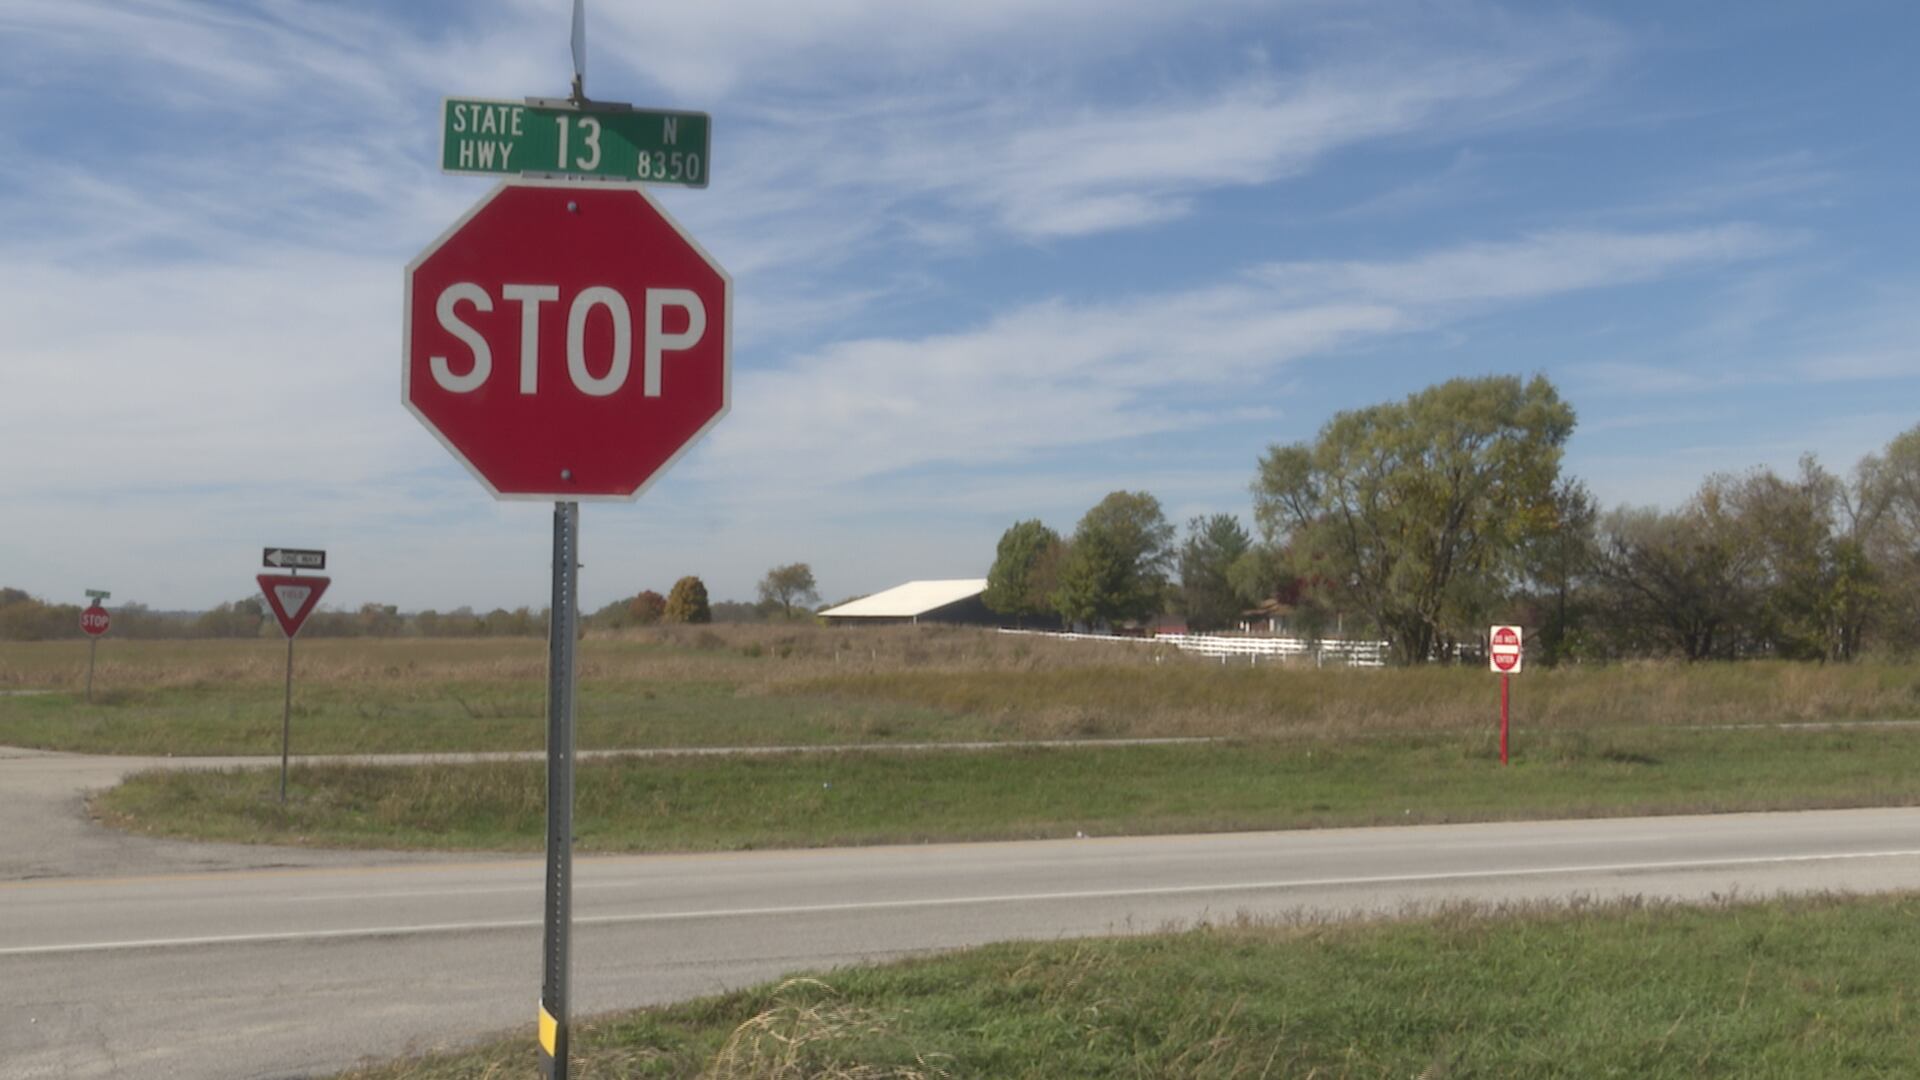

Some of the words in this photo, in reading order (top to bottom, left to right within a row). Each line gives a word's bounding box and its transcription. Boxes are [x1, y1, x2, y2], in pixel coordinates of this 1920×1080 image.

[453, 104, 524, 136] STATE
[663, 117, 678, 145] N
[459, 140, 514, 170] HWY
[556, 116, 601, 171] 13
[637, 151, 700, 180] 8350
[429, 281, 707, 397] STOP
[82, 614, 109, 627] STOP
